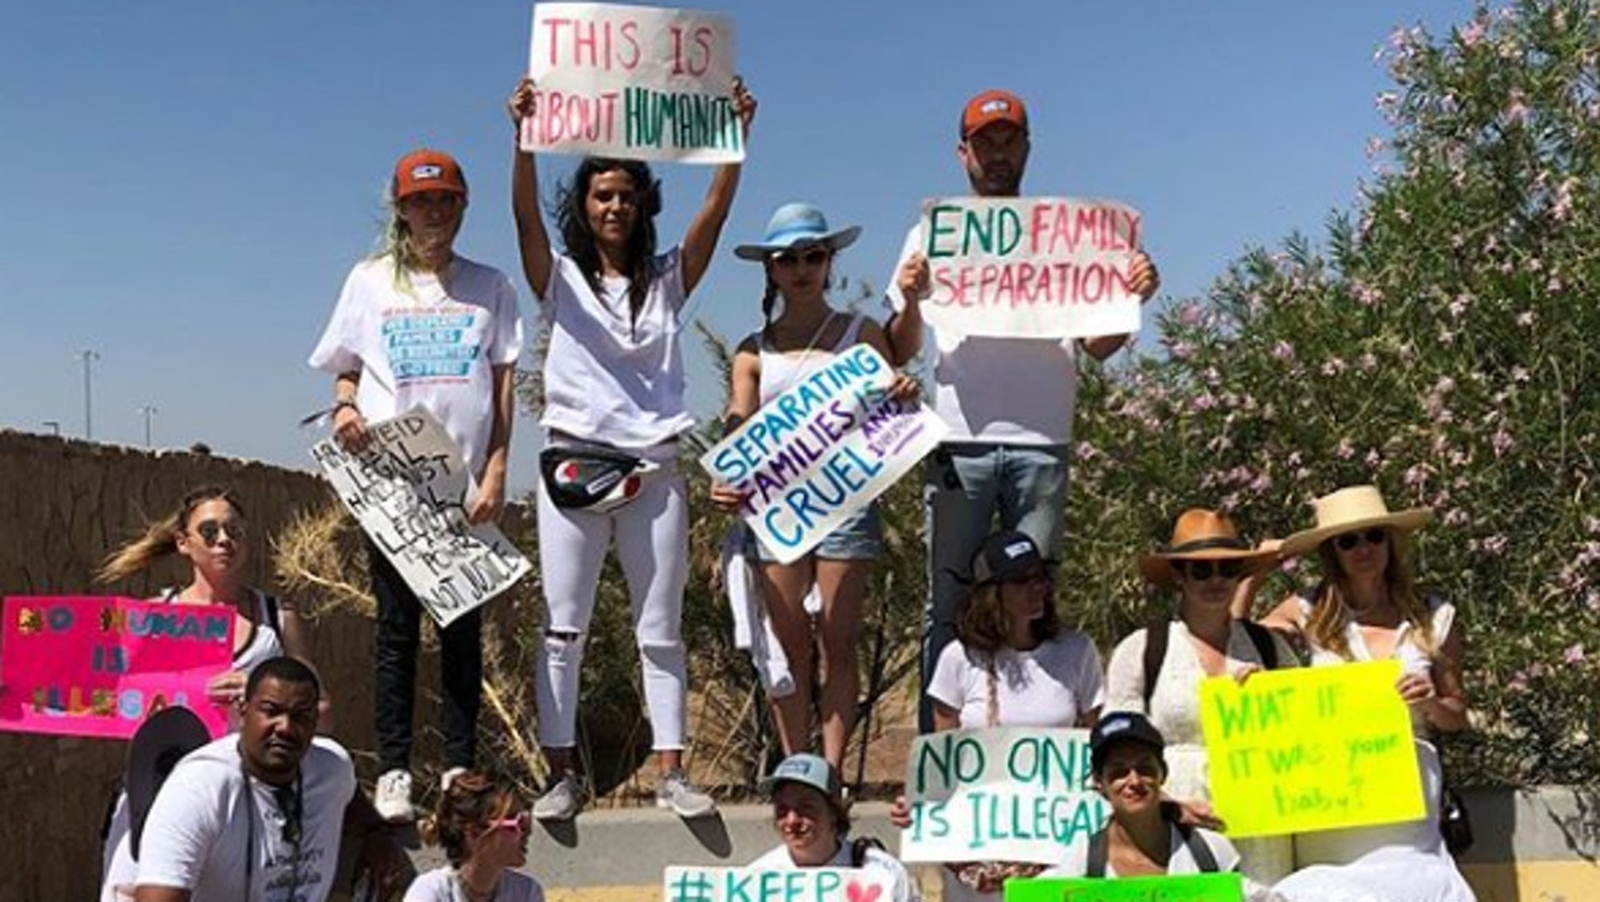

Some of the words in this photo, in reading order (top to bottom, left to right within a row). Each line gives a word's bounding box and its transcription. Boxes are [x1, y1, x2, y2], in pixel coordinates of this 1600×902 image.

[542, 18, 641, 71] THIS
[669, 26, 713, 77] IS
[524, 92, 619, 146] ABOUT
[928, 205, 1023, 259] END
[1030, 203, 1141, 254] FAMILY
[933, 261, 1132, 309] SEPARATION
[713, 347, 881, 483] SEPARATING
[737, 400, 856, 516] FAMILIES
[764, 446, 884, 547] CRUEL
[17, 606, 75, 636] NO
[99, 607, 230, 642] HUMAN
[92, 644, 128, 675] IS
[1214, 686, 1294, 740] WHAT
[916, 734, 986, 795] NO
[1006, 737, 1096, 793] ONE
[1228, 747, 1258, 780] IT
[1266, 743, 1326, 774] WAS
[910, 801, 951, 842] IS
